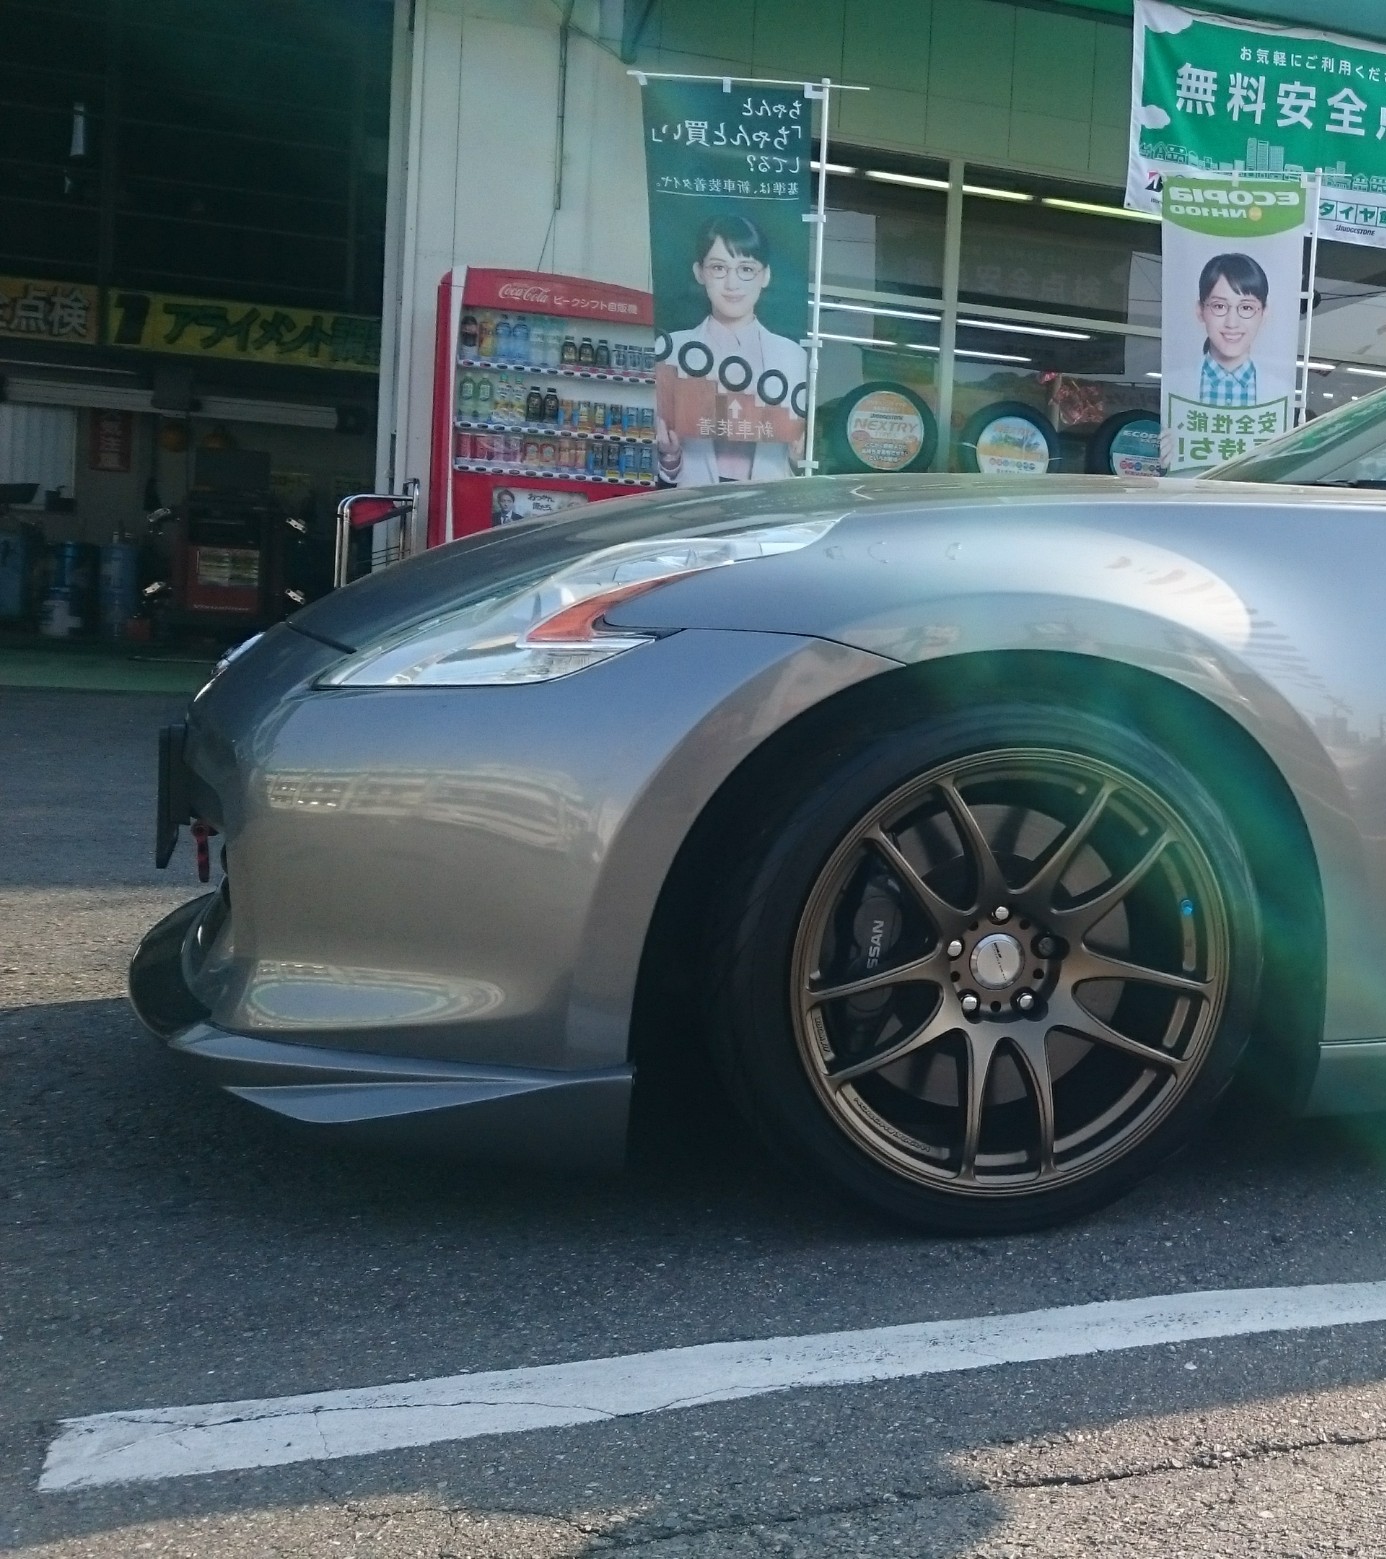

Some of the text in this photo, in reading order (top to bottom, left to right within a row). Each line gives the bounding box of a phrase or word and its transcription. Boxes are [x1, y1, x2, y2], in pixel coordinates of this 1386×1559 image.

[499, 283, 550, 303] Coca-Cola
[853, 416, 918, 434] NEXTRY
[1123, 430, 1161, 440] ECOP
[866, 919, 885, 970] SSAN
